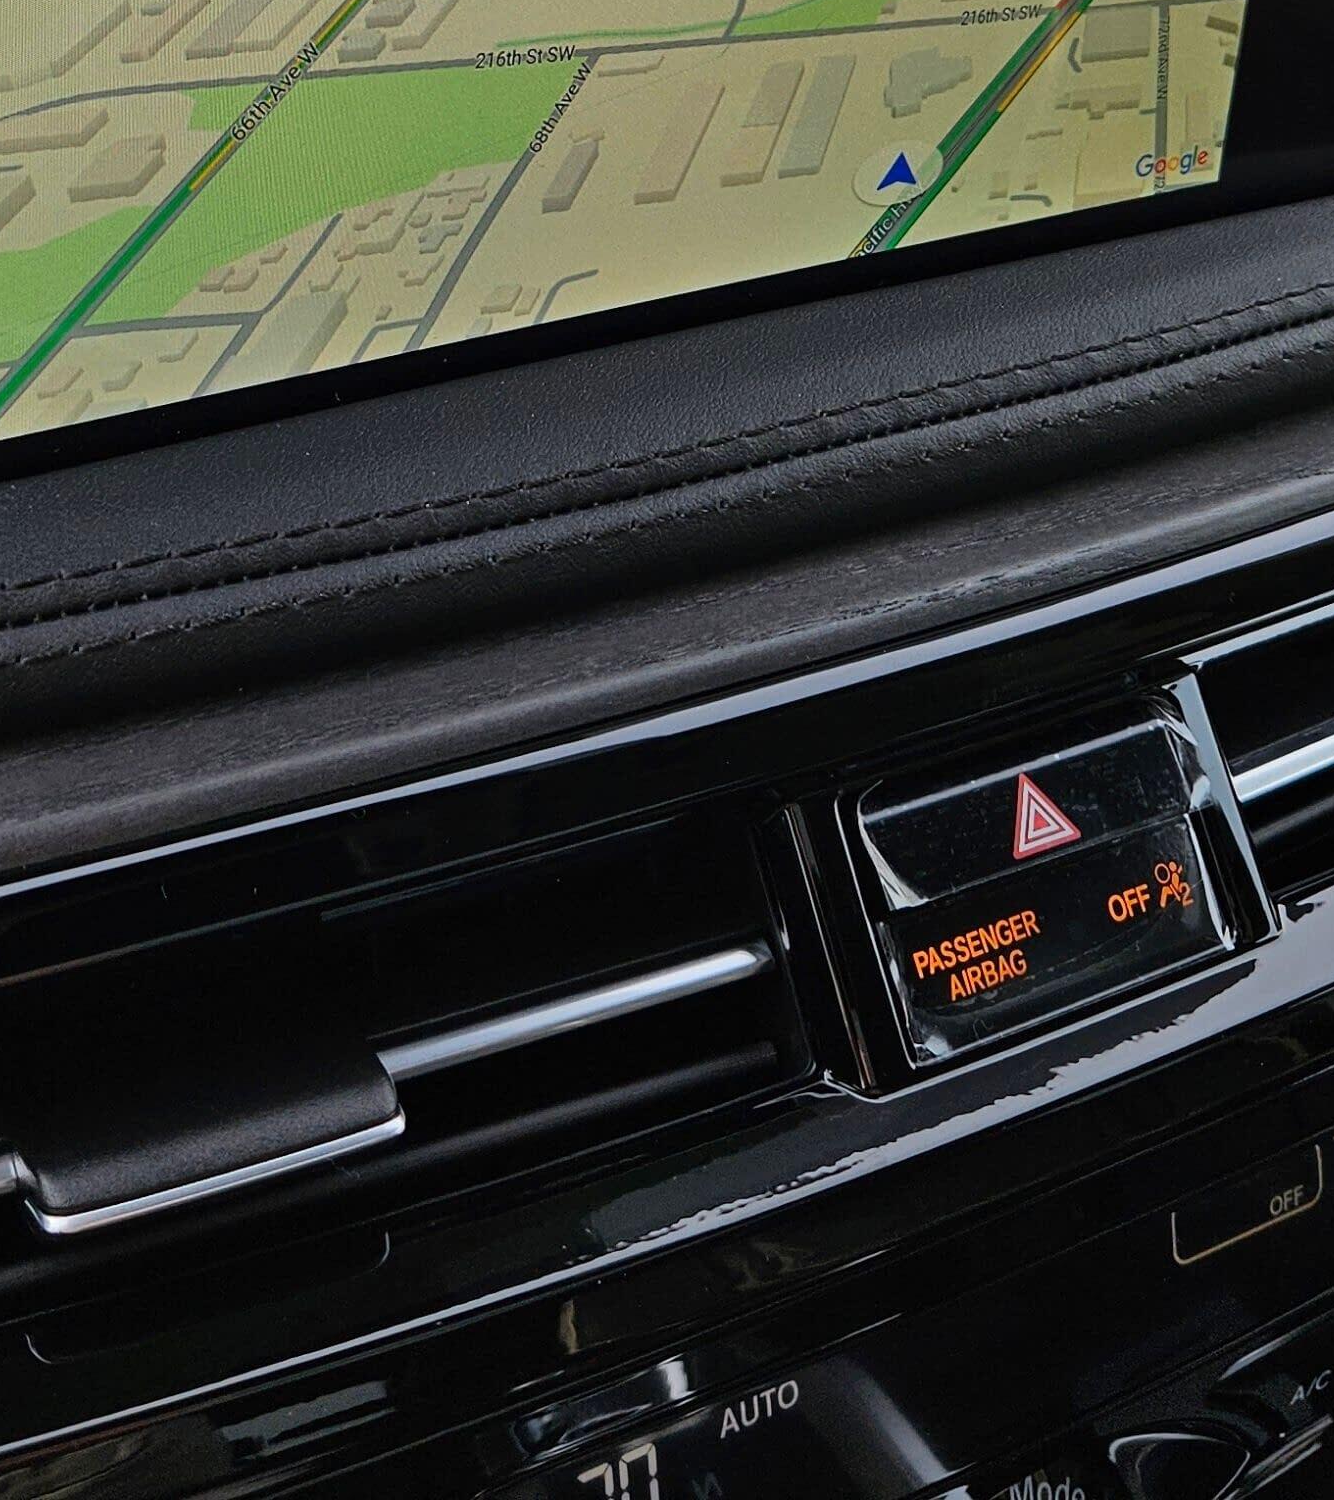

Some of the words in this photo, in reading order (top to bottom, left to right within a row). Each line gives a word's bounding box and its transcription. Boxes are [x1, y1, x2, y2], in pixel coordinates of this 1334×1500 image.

[961, 8, 998, 26] 216th
[1001, 7, 1016, 22] St
[1018, 4, 1043, 20] SW
[475, 50, 519, 70] 216th
[524, 48, 542, 66] St
[545, 45, 576, 64] SW
[230, 99, 273, 142] 66th
[269, 67, 304, 102] Ave
[297, 41, 320, 66] W
[529, 114, 559, 154] 68th
[553, 81, 579, 114] Ave
[572, 61, 592, 83] W
[1136, 145, 1208, 177] Google
[1108, 883, 1151, 923] OFF
[913, 909, 1041, 980] PASSENGER
[949, 948, 1028, 1002] AIRBAG
[1269, 1184, 1305, 1217] OFF
[1290, 1369, 1331, 1406] A/C
[719, 1378, 800, 1441] AUTO
